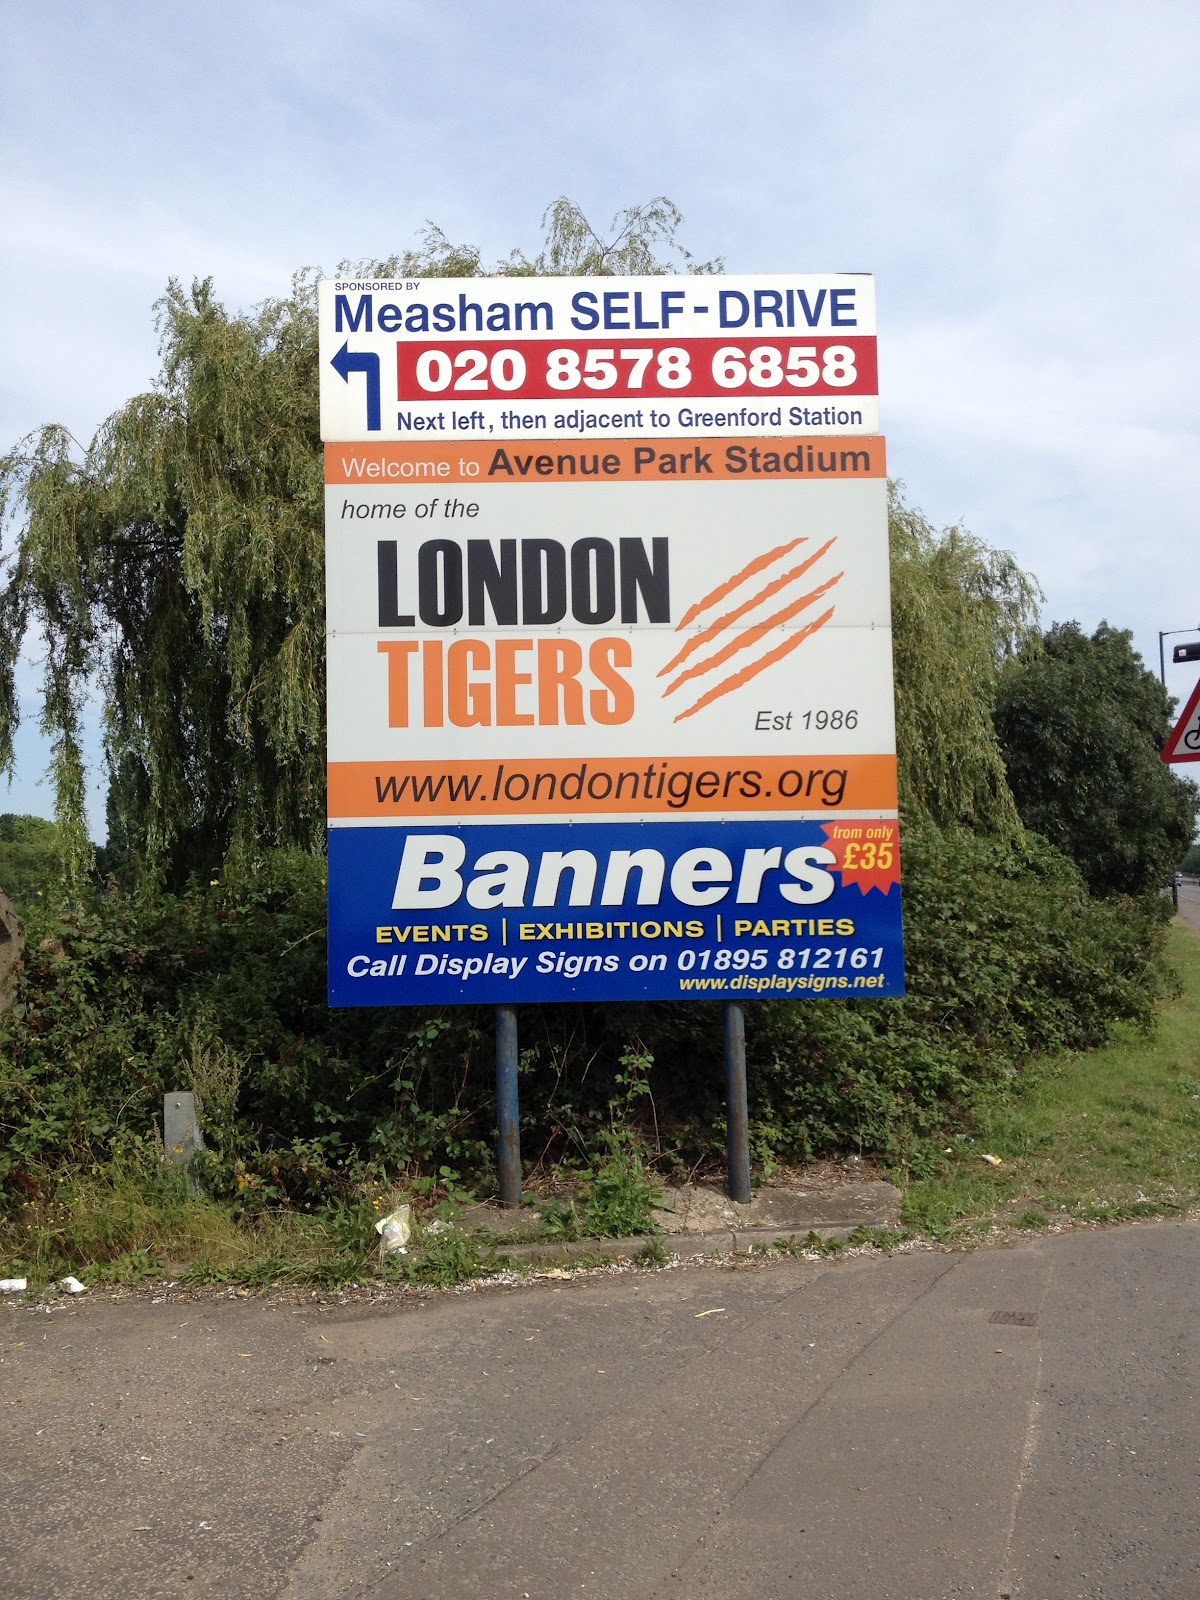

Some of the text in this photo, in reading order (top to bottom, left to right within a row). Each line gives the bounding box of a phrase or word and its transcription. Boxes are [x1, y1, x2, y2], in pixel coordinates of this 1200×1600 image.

[334, 282, 420, 291] SPONSORED BY
[335, 294, 553, 332] Measham
[416, 345, 858, 393] 020 8578 6858
[397, 412, 446, 431] Next
[500, 411, 547, 430] then
[553, 410, 643, 432] adjacent
[650, 410, 671, 427] to
[677, 408, 783, 427] Greenford
[789, 407, 862, 426] Station
[342, 444, 870, 478] Welcome to Avenue Park Stadium
[341, 499, 479, 519] home of the
[377, 537, 671, 628] LONDON
[378, 637, 634, 728] TIGERS
[754, 709, 858, 730] Est 1986
[375, 764, 848, 807] www.londontigers.org
[833, 826, 893, 842] from only
[843, 842, 893, 870] £35
[391, 834, 837, 910] Banners
[376, 918, 854, 943] EVENTS EXHIBITIONS PARTIES
[346, 948, 883, 980] Call Display Signs on 01895 812161
[679, 974, 884, 992] www.displaysigns.net
